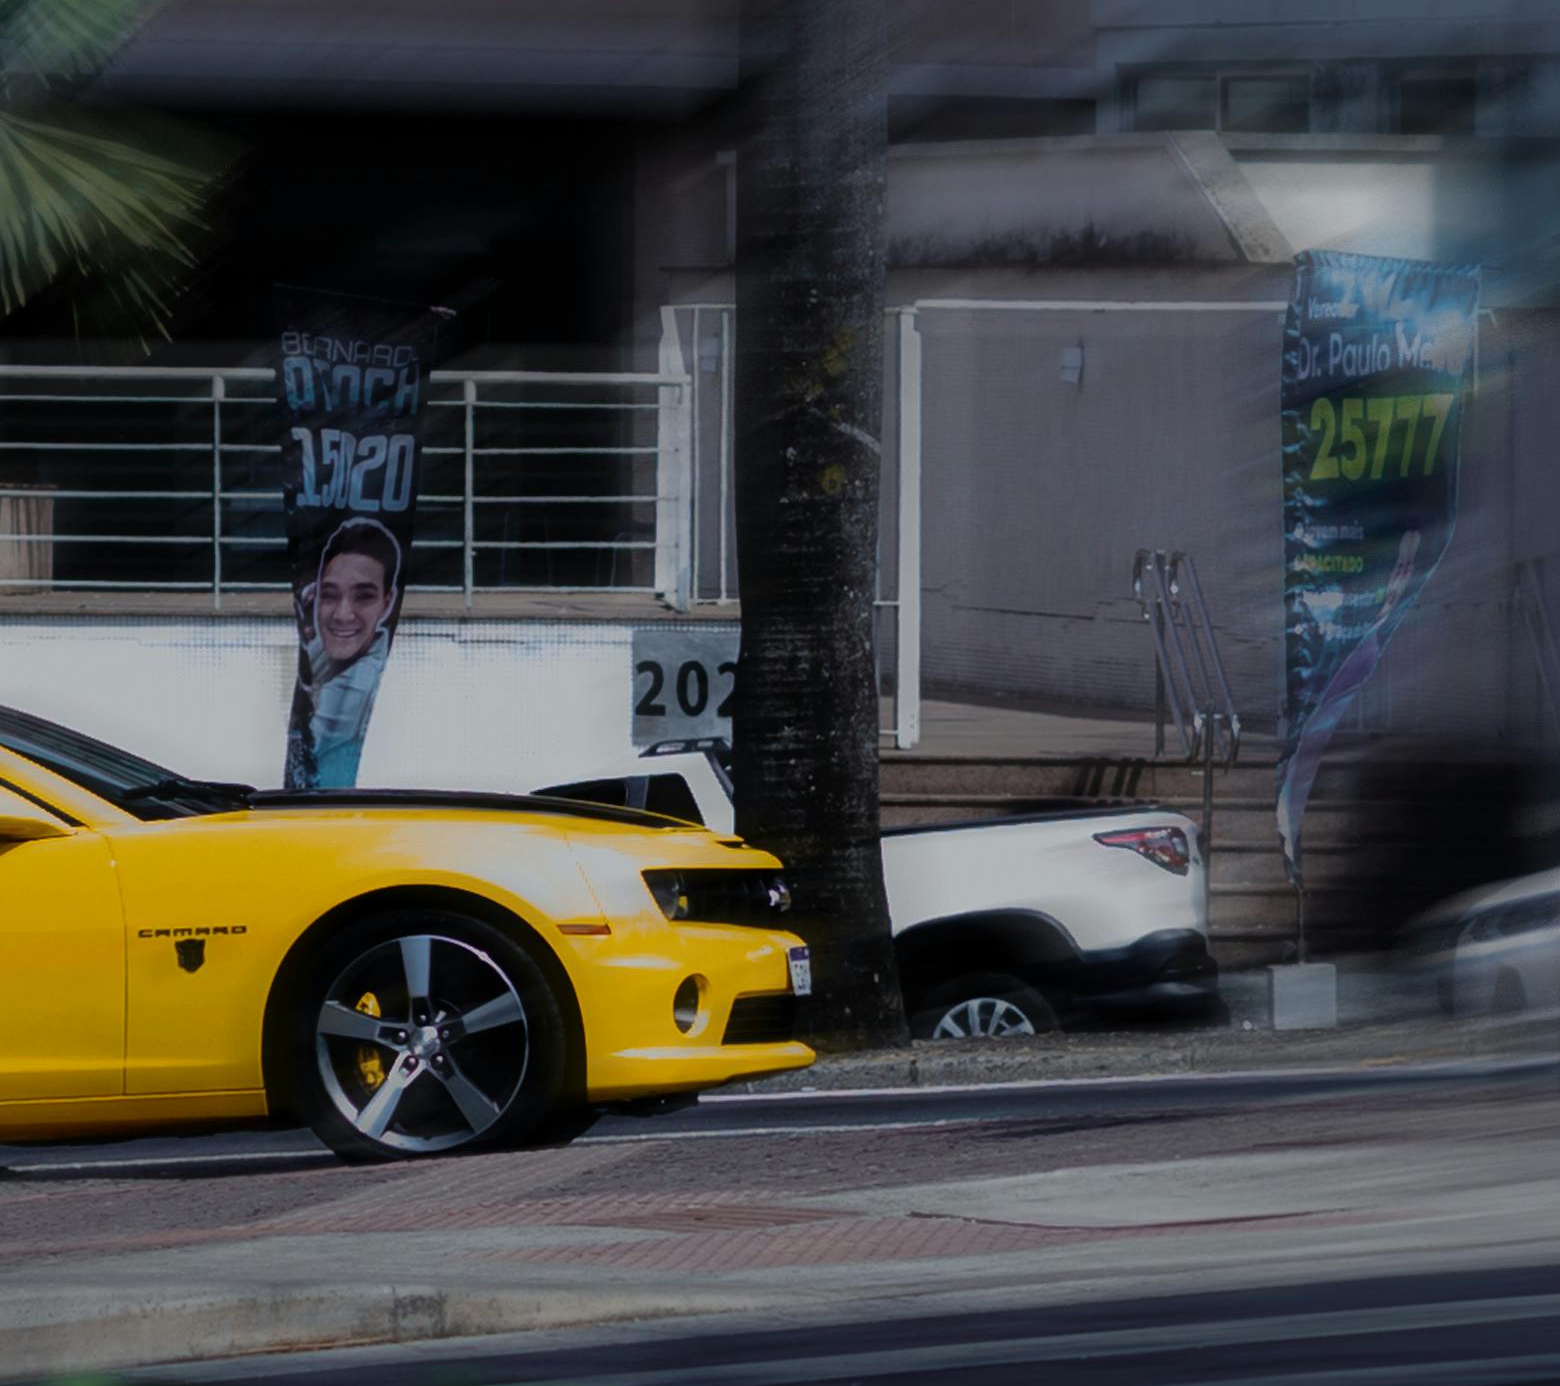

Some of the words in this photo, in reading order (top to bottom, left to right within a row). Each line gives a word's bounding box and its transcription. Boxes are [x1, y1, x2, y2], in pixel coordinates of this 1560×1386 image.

[1329, 332, 1391, 377] Paulo
[291, 426, 416, 513] 15020
[1309, 393, 1454, 481] 25777
[137, 925, 248, 939] CAMARO
